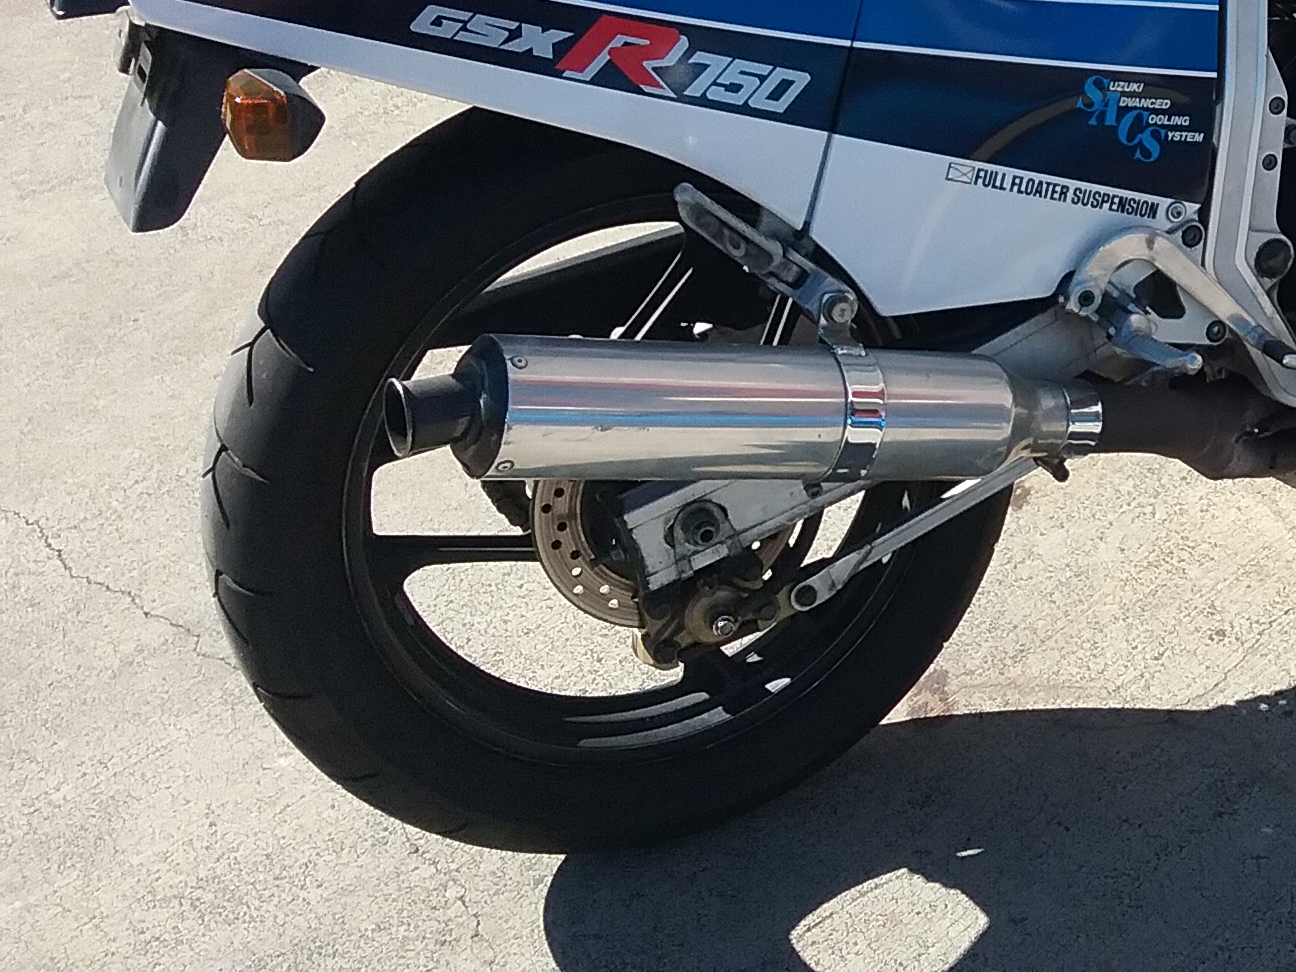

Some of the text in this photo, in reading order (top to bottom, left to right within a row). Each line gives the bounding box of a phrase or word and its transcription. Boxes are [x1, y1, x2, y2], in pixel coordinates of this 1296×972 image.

[973, 167, 1160, 220] FULL FLOATER SUSPENSION
